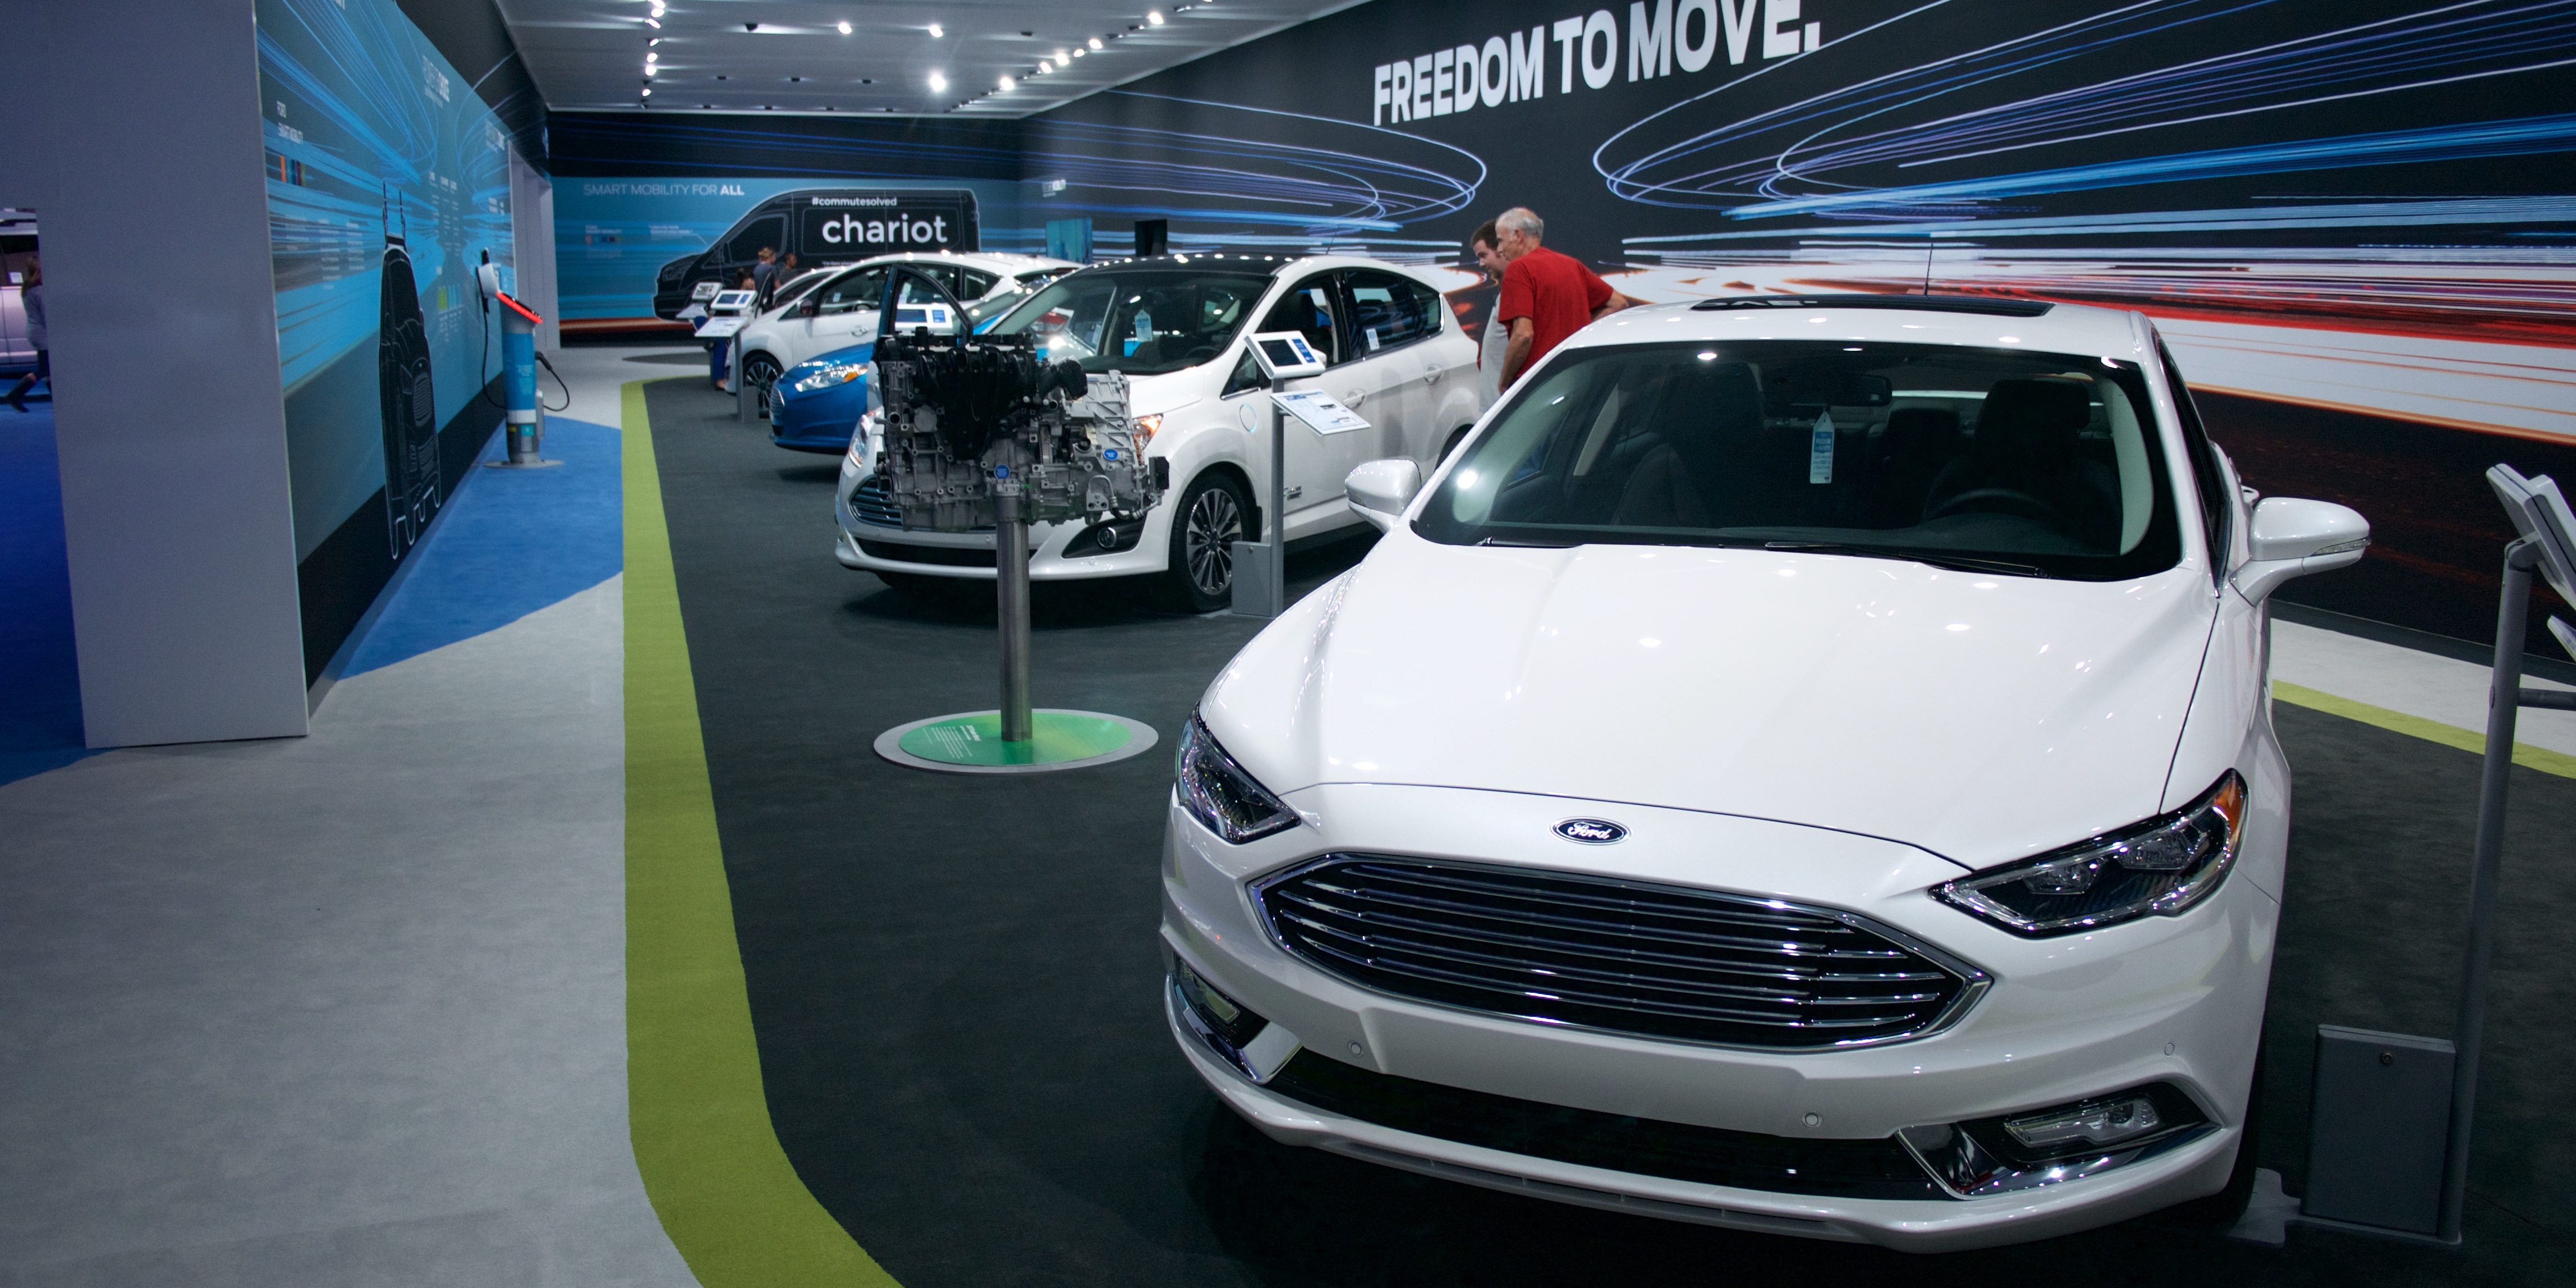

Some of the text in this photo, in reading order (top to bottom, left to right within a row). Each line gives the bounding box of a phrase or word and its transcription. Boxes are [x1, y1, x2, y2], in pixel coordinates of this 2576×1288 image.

[1373, 0, 1820, 126] FREEDOM TO MOVE.
[584, 184, 745, 196] SMART MOBILITY FOR ALL
[812, 196, 898, 207] #commutesolved
[822, 213, 948, 244] chariot
[1567, 821, 1613, 840] Ford
